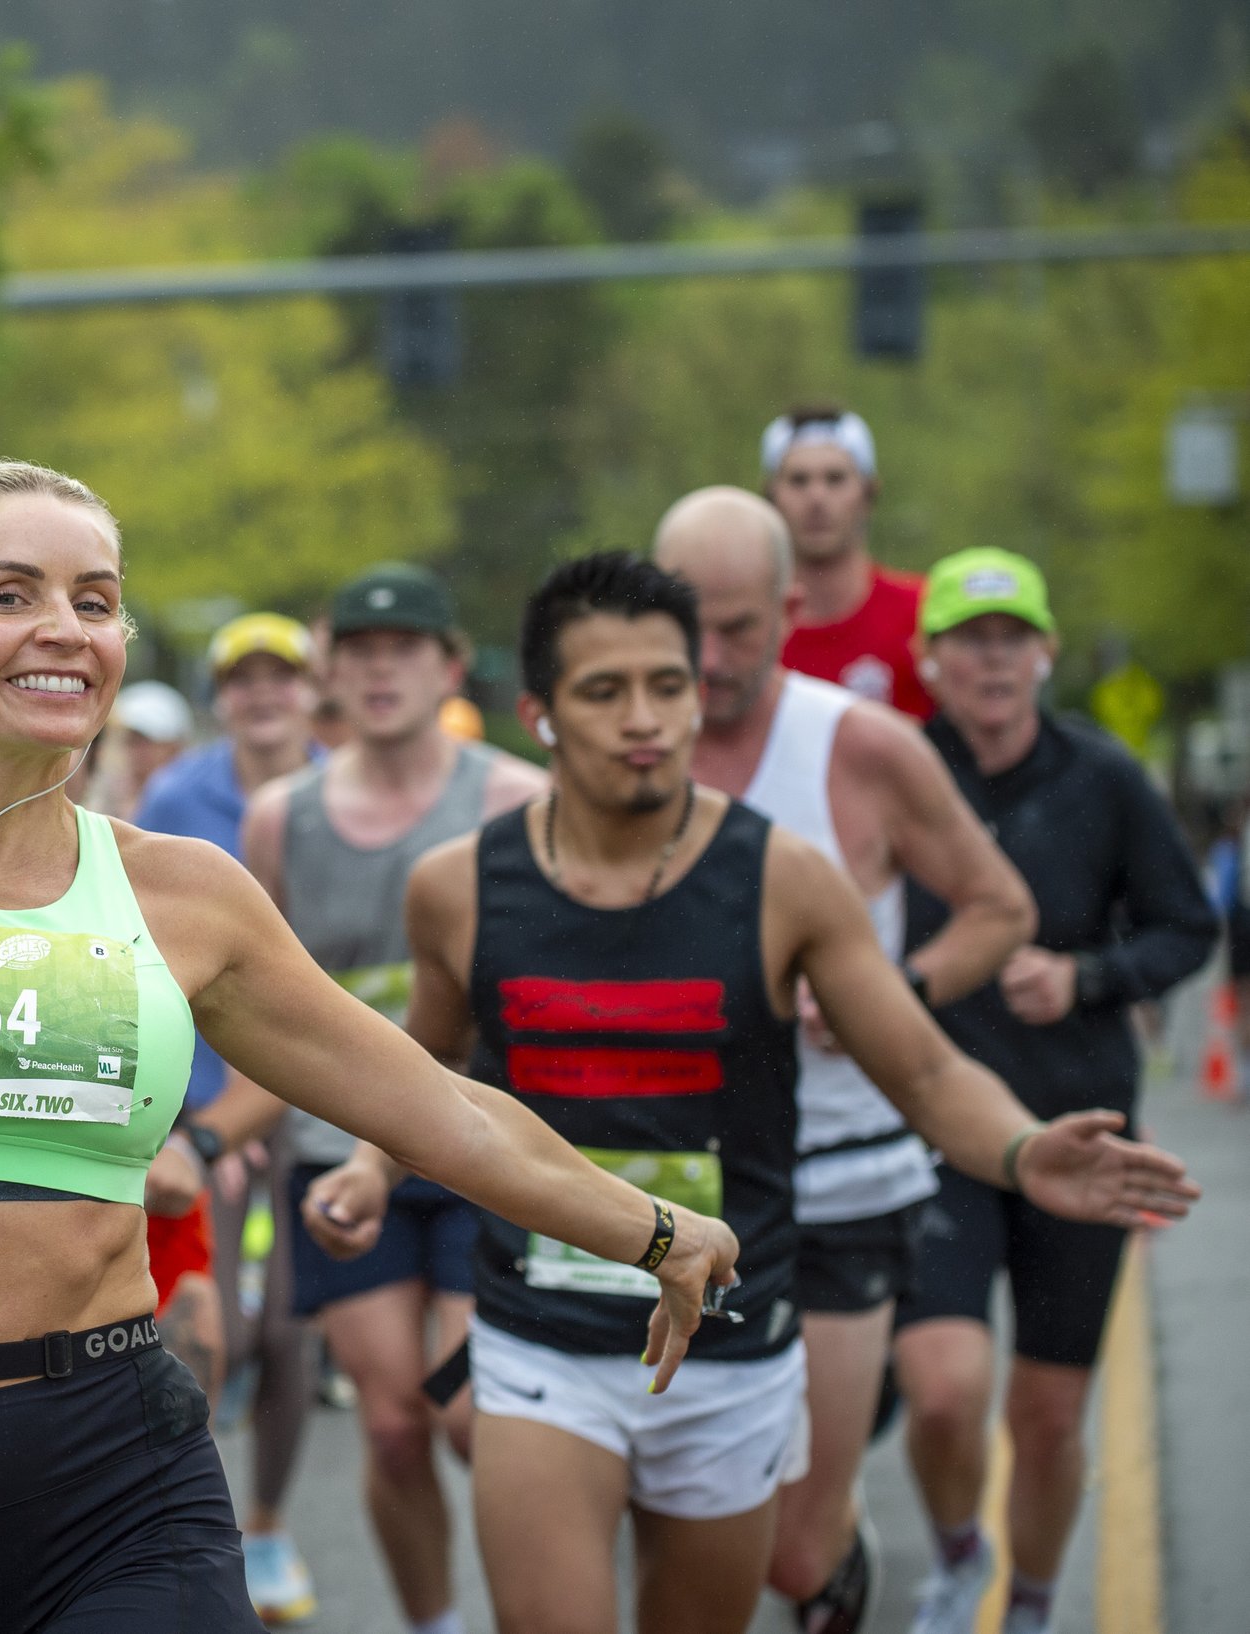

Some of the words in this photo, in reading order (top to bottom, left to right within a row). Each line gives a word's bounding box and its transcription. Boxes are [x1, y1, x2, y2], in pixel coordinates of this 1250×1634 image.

[95, 947, 105, 956] B
[96, 1045, 111, 1053] Shirt
[111, 1046, 124, 1054] Size
[32, 1060, 84, 1073] PeaceHealth
[648, 1237, 671, 1267] VIP
[85, 1318, 160, 1359] GOALS
